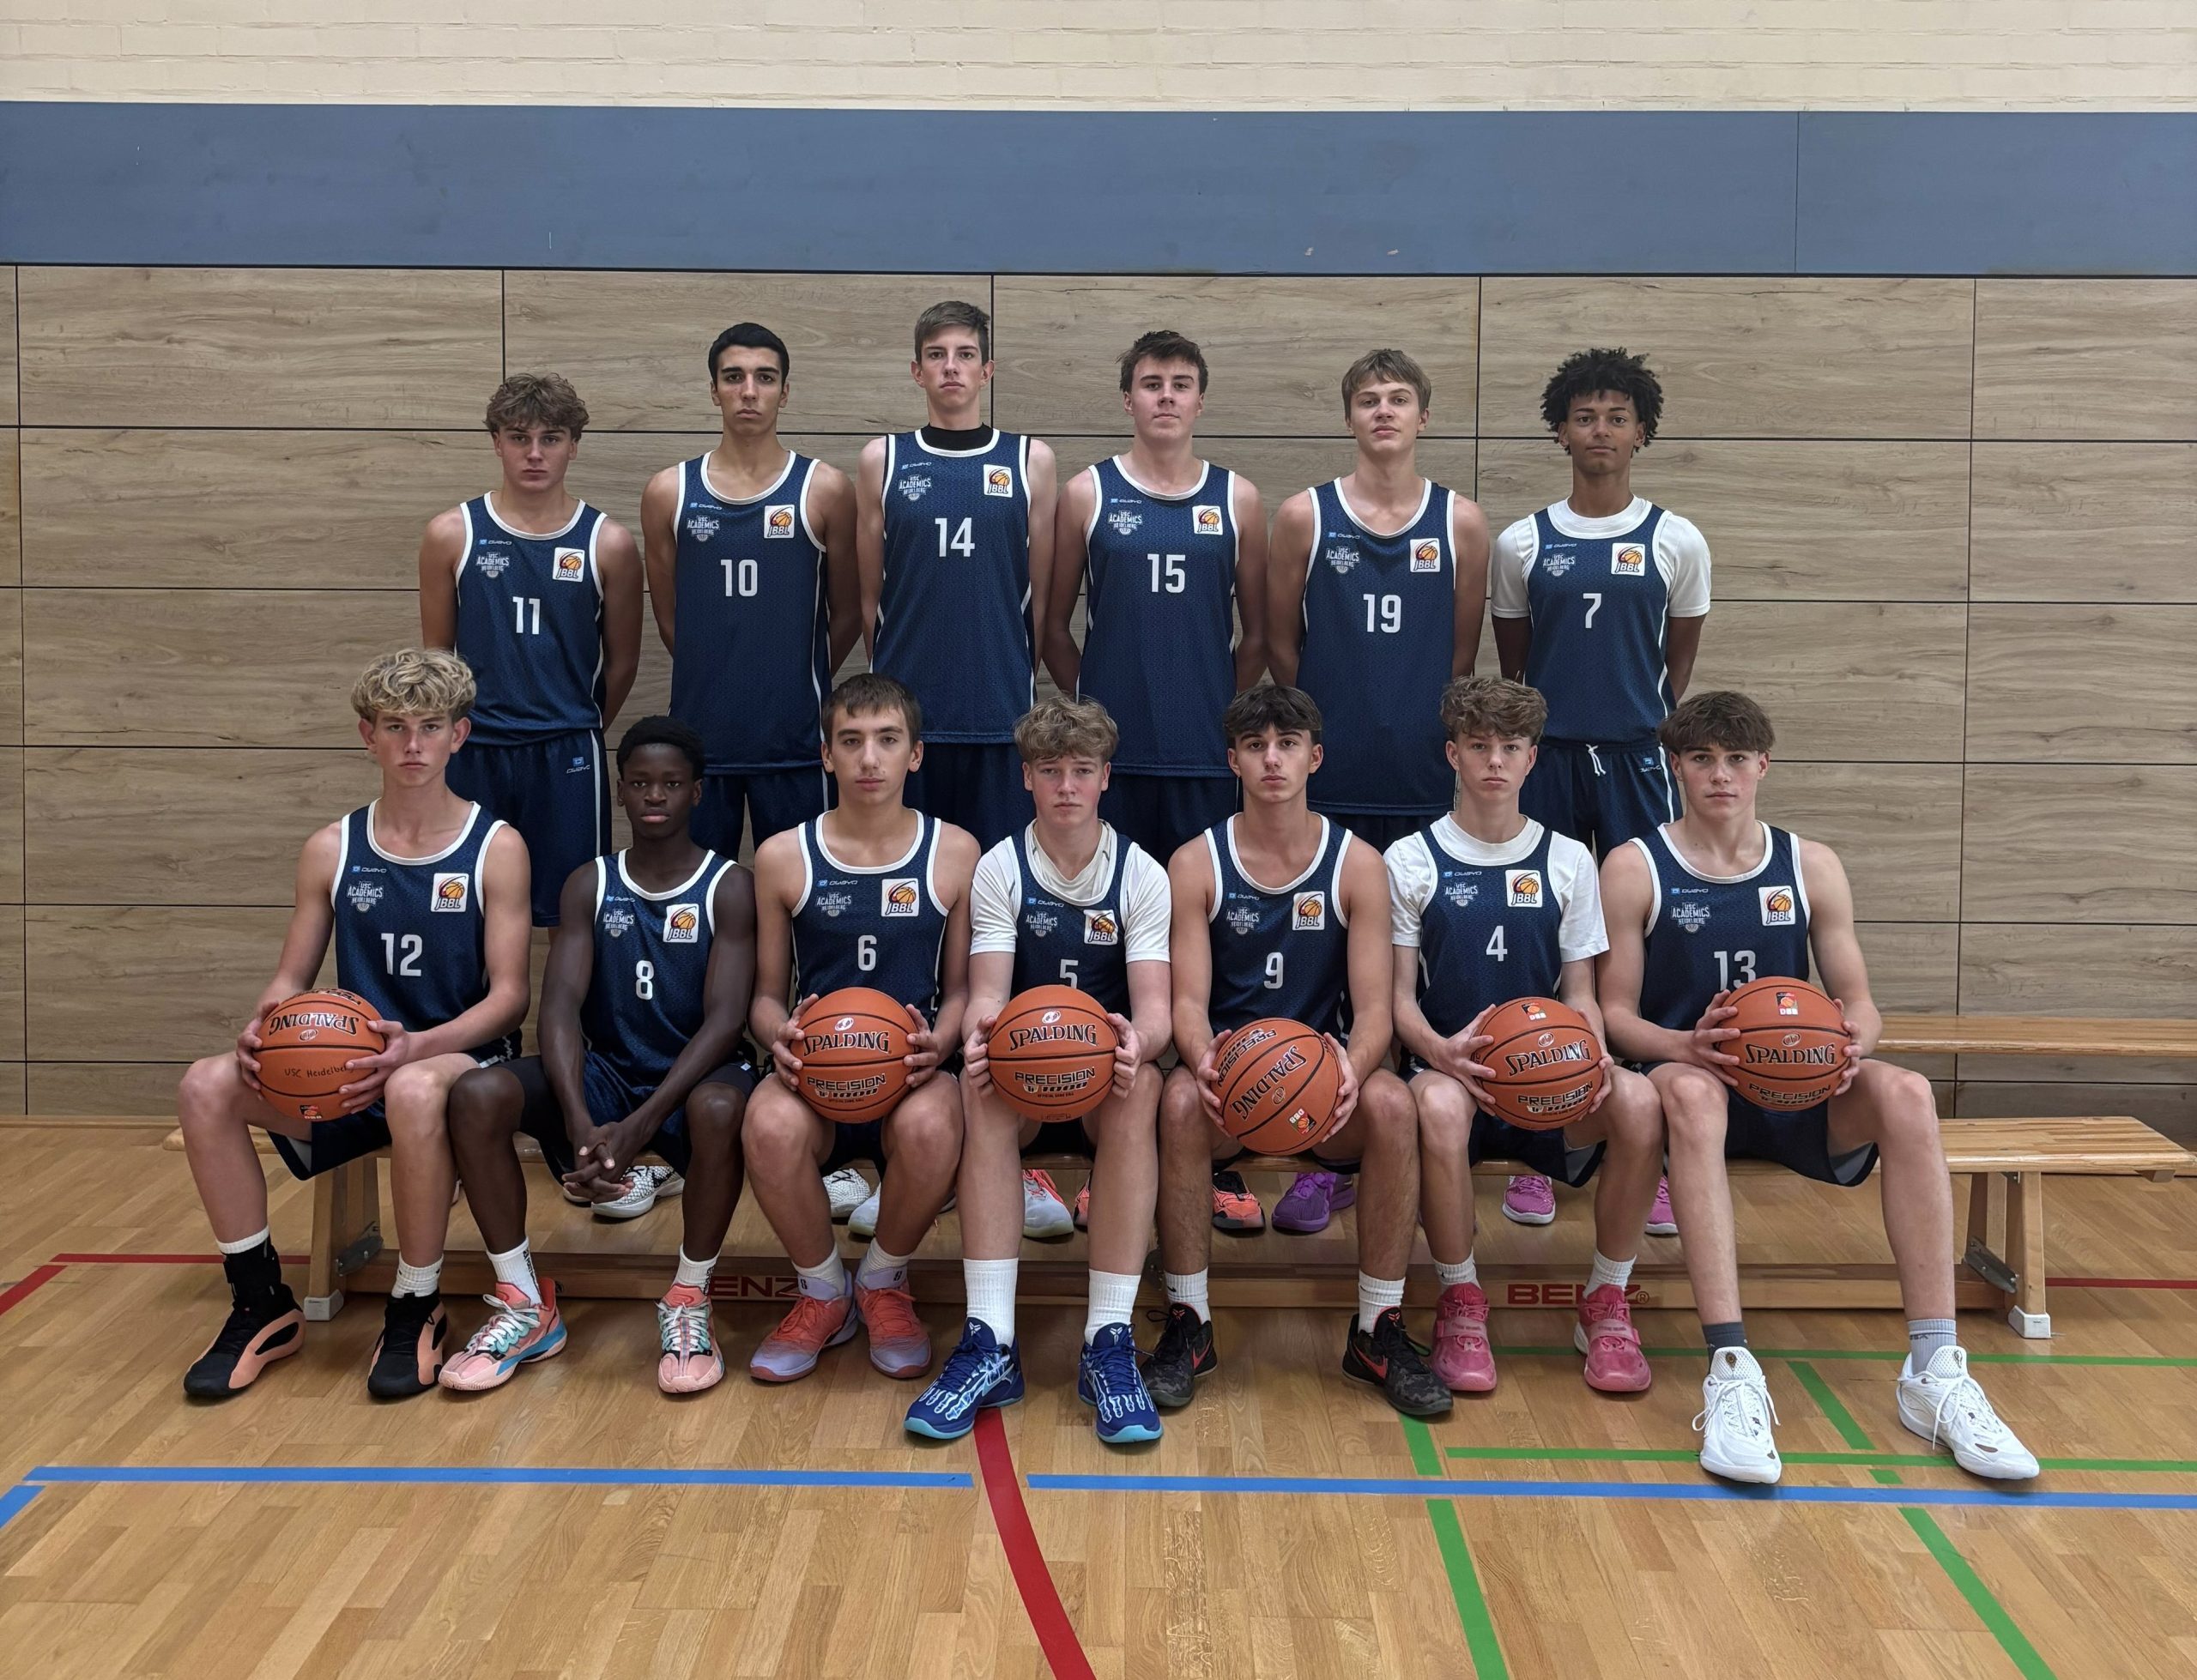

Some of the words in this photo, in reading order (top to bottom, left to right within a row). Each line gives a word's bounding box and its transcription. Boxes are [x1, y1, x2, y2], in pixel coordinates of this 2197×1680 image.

[899, 478, 931, 490] ACADEMICS
[987, 484, 1008, 494] JBBL
[687, 520, 719, 529] ACADEMICS
[1109, 515, 1142, 524] ACADEMICS
[767, 526, 790, 537] JBBL
[1197, 523, 1219, 533] JBBL
[935, 517, 975, 557] 14
[476, 555, 510, 566] ACADEMICS
[1326, 550, 1359, 562] ACADEMICS
[1543, 557, 1575, 566] ACADEMICS
[1413, 559, 1436, 571] JBBL
[1614, 563, 1640, 573] JBBL
[556, 568, 578, 578] JBBL
[721, 559, 758, 596] 10
[1147, 553, 1186, 593] 15
[512, 596, 541, 635] 11
[1363, 594, 1401, 633] 19
[1583, 593, 1601, 629] 7
[348, 885, 383, 897] ACADEMICS
[1445, 885, 1478, 896] ACADEMICS
[434, 897, 461, 910] JBBL
[816, 896, 851, 906] ACADEMICS
[1511, 893, 1537, 905] JBBL
[885, 903, 912, 916] JBBL
[1226, 911, 1259, 922] ACADEMICS
[1672, 907, 1710, 918] ACADEMICS
[603, 913, 634, 924] ACADEMICS
[1026, 915, 1057, 927] ACADEMICS
[1295, 916, 1319, 928] JBBL
[1766, 910, 1791, 924] JBBL
[667, 928, 693, 940] JBBL
[1088, 931, 1112, 942] JBBL
[1486, 925, 1508, 961] 4
[380, 933, 422, 976] 12
[858, 934, 877, 971] 6
[1059, 958, 1079, 989] 5
[1263, 952, 1284, 989] 9
[1714, 950, 1756, 991] 13
[636, 960, 654, 1000] 8
[269, 1012, 359, 1036] SPALDING
[803, 1031, 890, 1057] SPALDING
[1009, 1024, 1099, 1052] SPALDING
[1217, 1029, 1277, 1087] PRECISION
[1504, 1039, 1593, 1077] SPALDING
[1745, 1043, 1836, 1065] SPALDING
[284, 1068, 301, 1078] USC
[306, 1065, 354, 1079] Heidelber
[1014, 1067, 1095, 1085] PRECISION
[807, 1073, 886, 1091] PRECISION
[1230, 1044, 1307, 1121] SPALDING
[1517, 1081, 1593, 1106] PRECISION
[1749, 1083, 1831, 1100] PRECISION
[710, 1276, 802, 1298] ENZ
